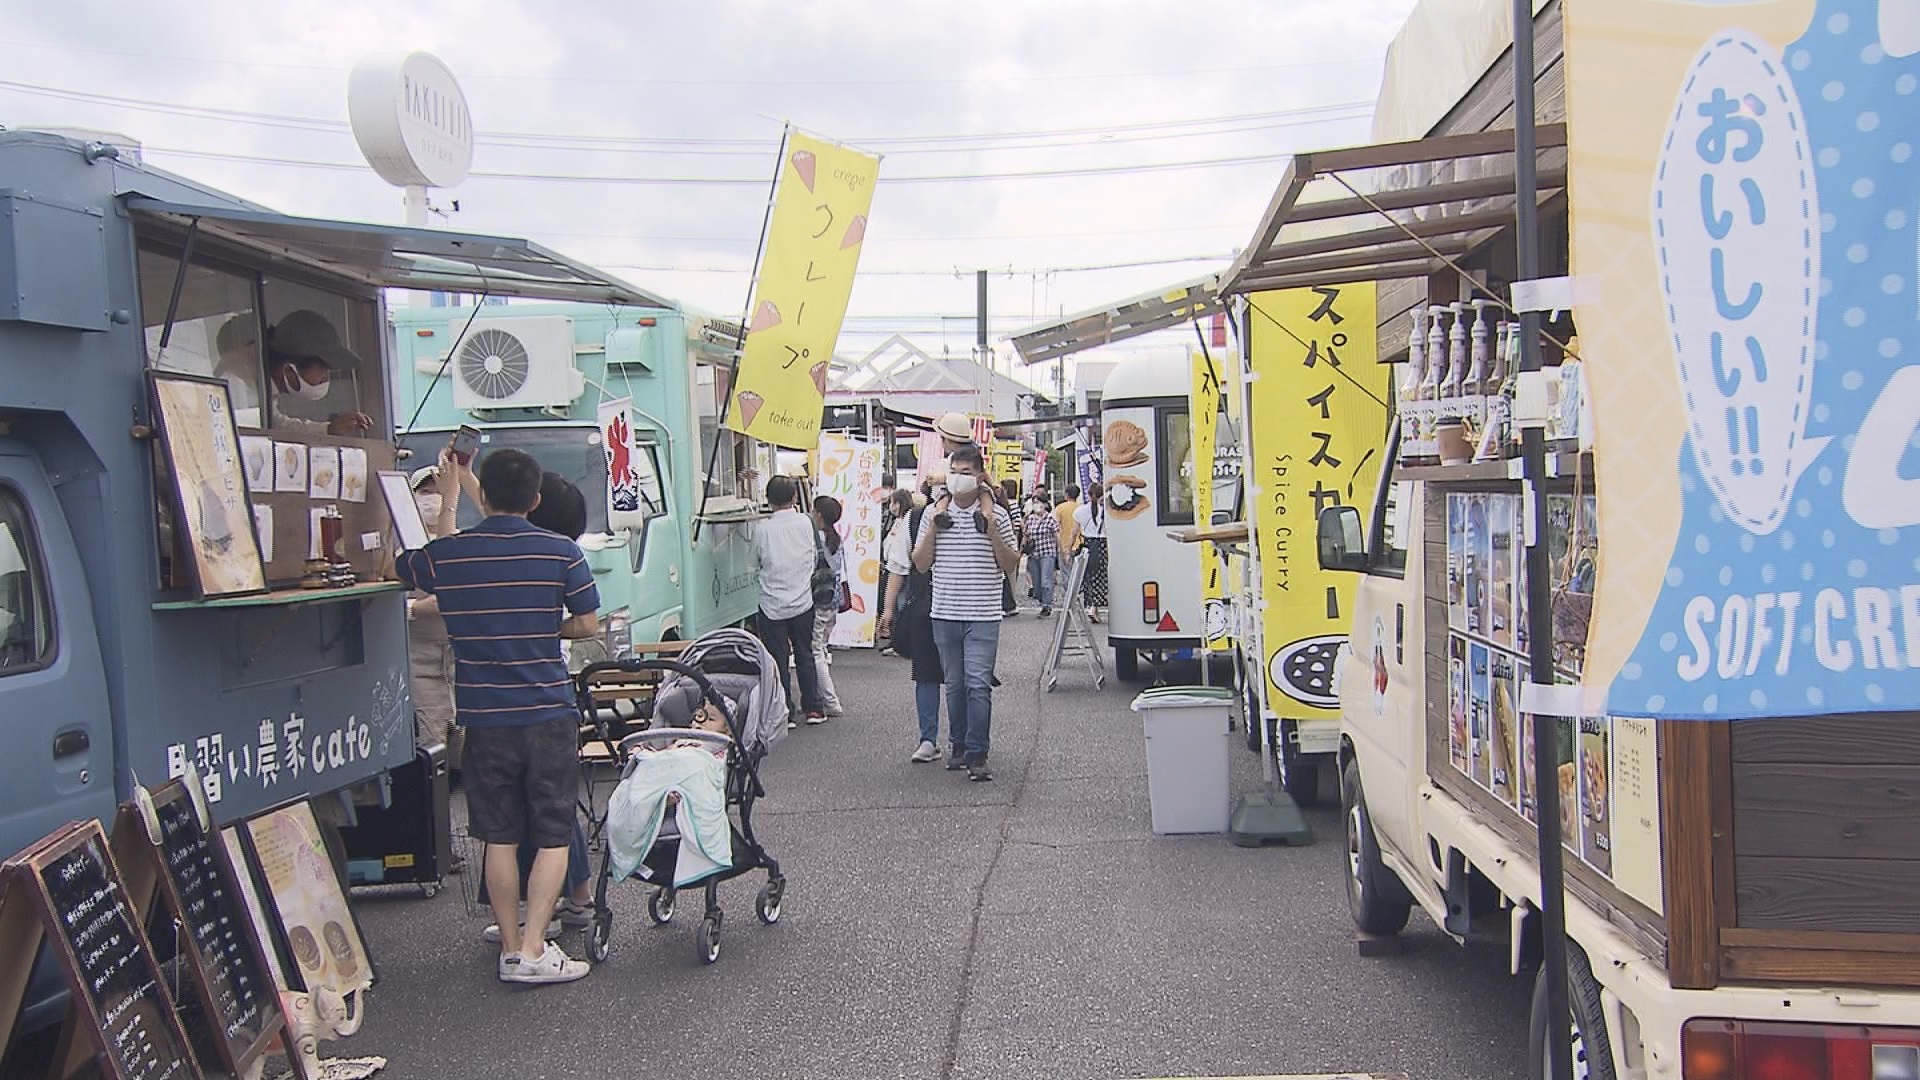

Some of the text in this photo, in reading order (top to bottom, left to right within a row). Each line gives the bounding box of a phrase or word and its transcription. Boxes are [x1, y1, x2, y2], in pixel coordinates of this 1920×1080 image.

[832, 167, 867, 191] crepe
[768, 408, 814, 431] take out
[1302, 285, 1348, 620] スパイスカー
[1271, 453, 1293, 591] Spice Curry
[1676, 584, 1920, 683] SOFT CRE
